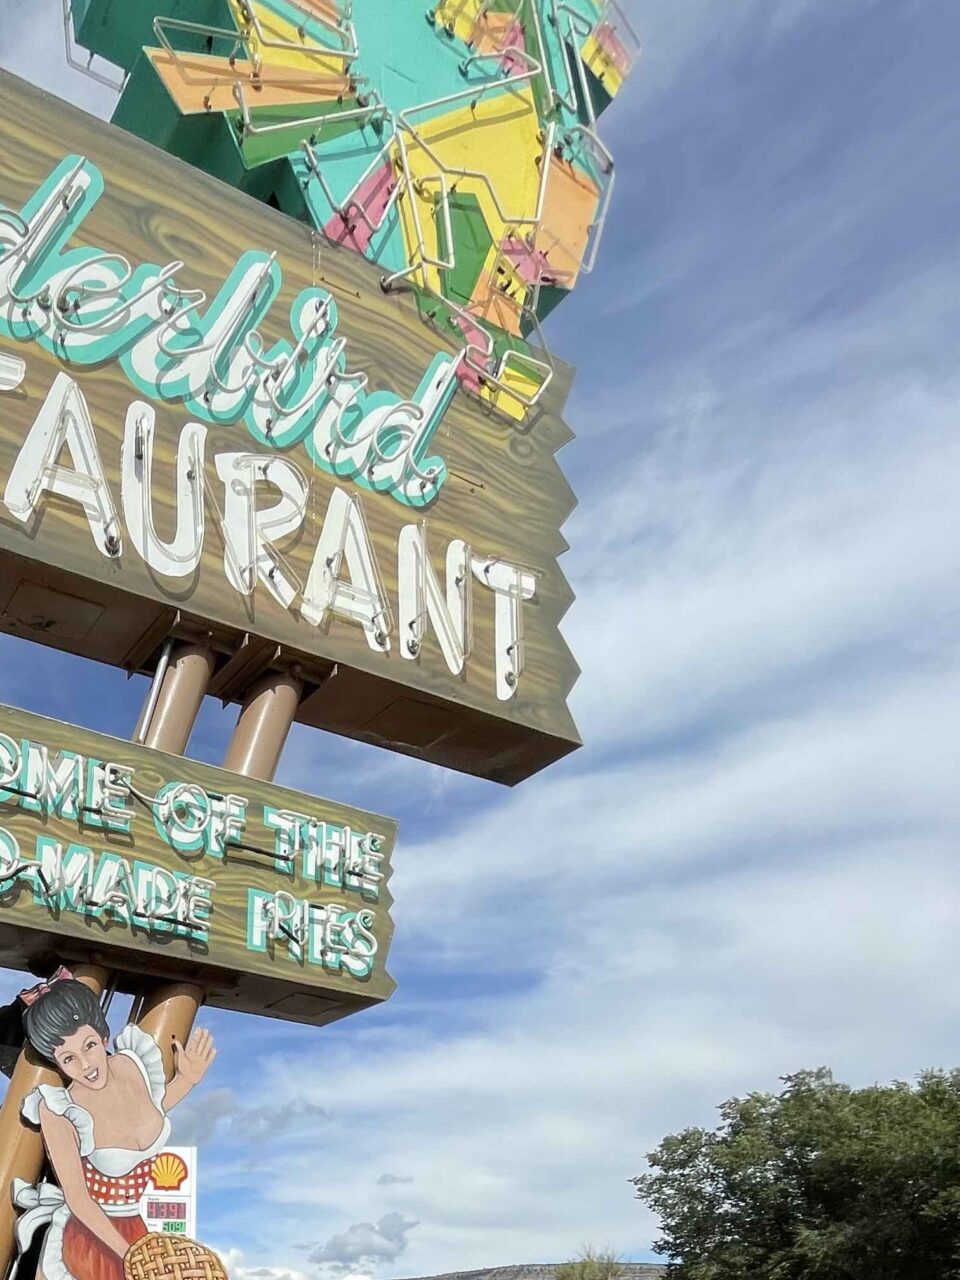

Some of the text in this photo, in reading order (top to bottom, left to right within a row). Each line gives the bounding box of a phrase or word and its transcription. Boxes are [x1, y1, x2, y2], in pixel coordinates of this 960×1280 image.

[154, 780, 248, 857] OF
[264, 806, 385, 894] THE
[246, 887, 378, 978] PIES
